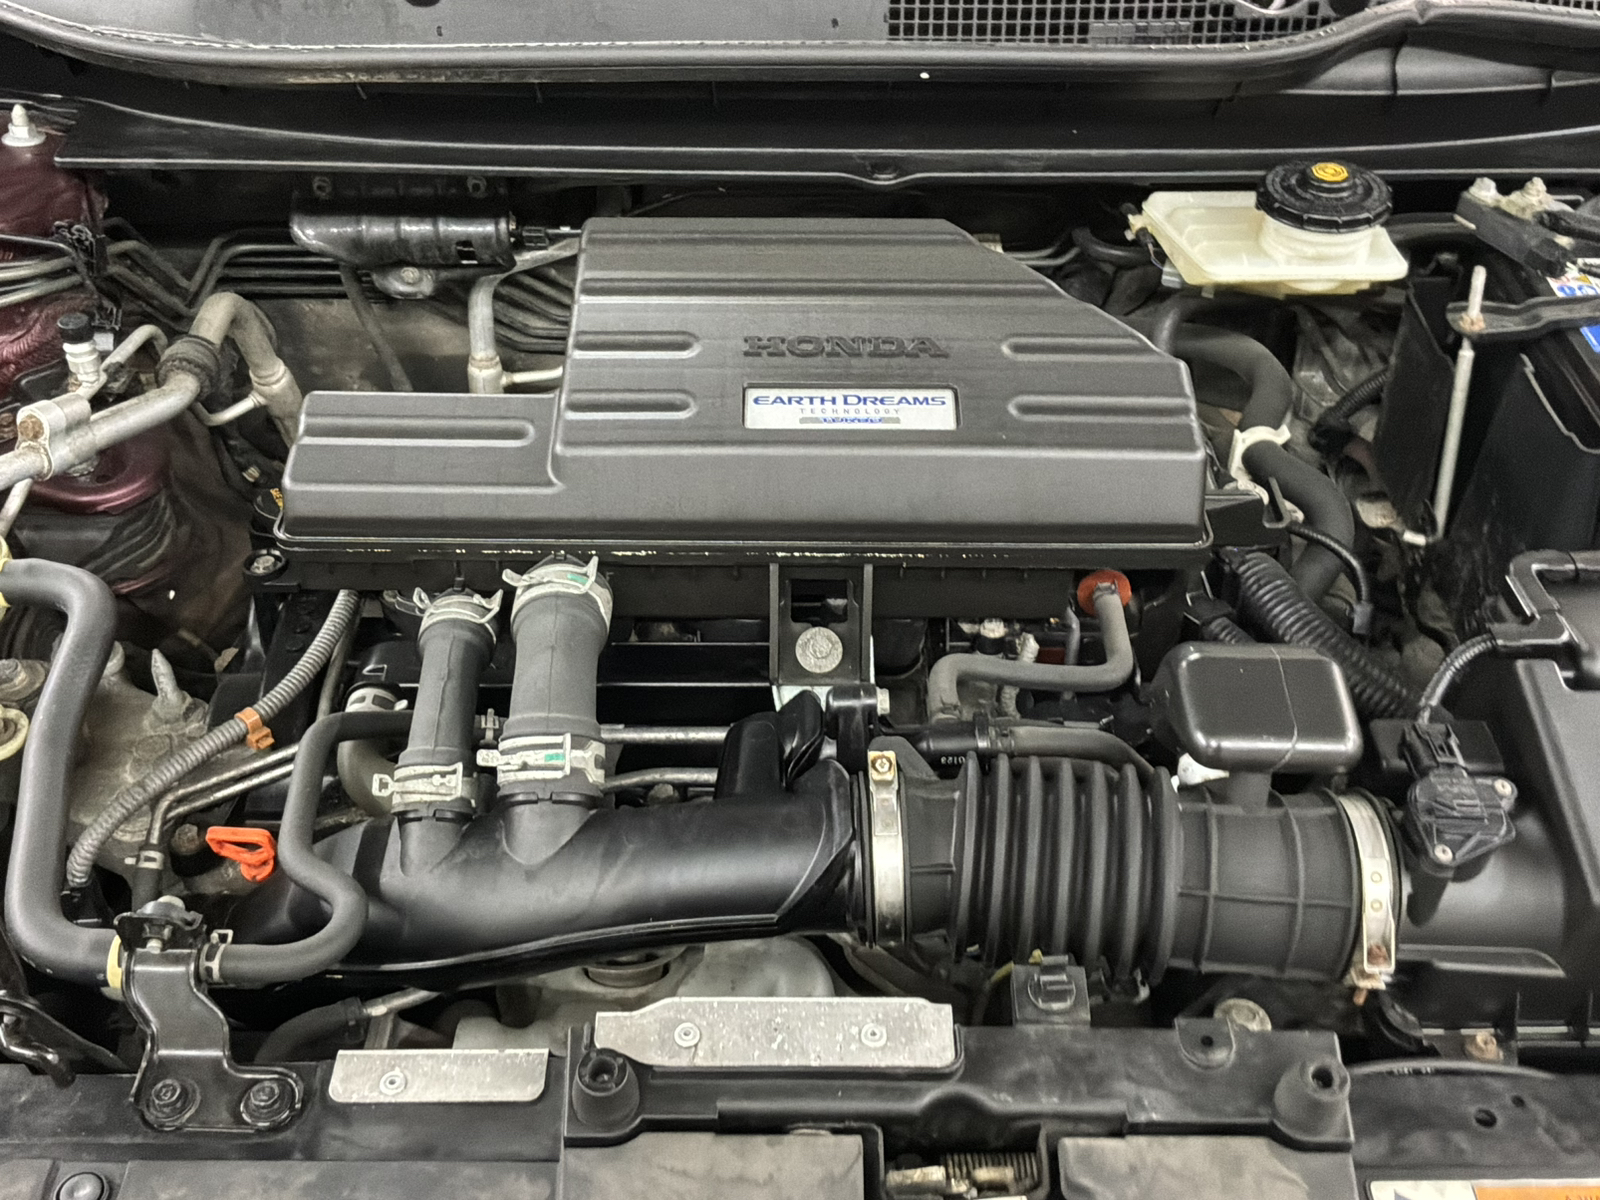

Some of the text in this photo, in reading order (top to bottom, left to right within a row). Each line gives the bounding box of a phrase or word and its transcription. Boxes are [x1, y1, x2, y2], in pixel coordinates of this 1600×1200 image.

[743, 335, 949, 358] HONDA
[752, 394, 947, 406] EARTH DREAMS
